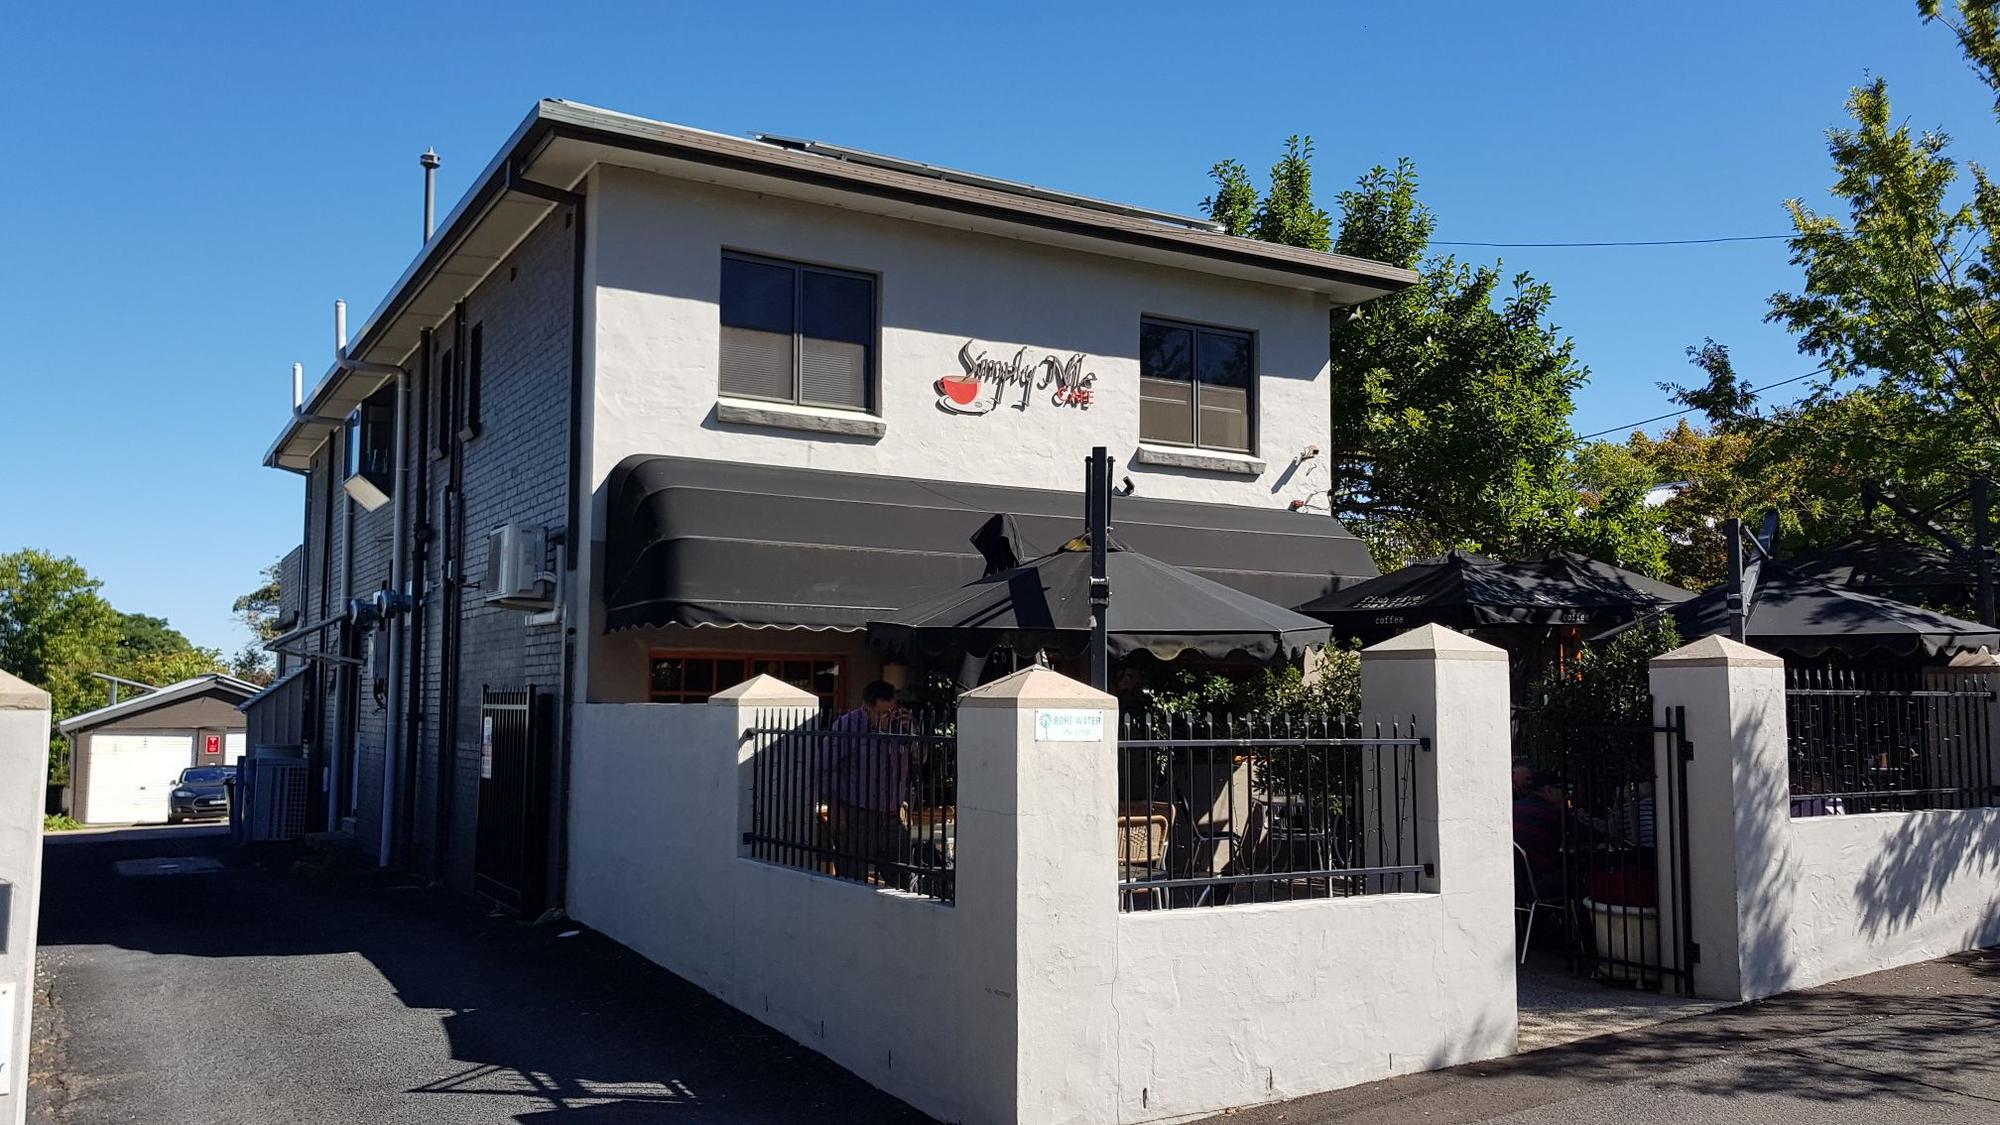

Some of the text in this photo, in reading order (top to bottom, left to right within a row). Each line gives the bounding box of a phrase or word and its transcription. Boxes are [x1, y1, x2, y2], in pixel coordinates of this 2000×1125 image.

[958, 339, 1036, 412] Simply
[1375, 615, 1404, 624] coffee
[1053, 716, 1101, 725] BORE WATER
